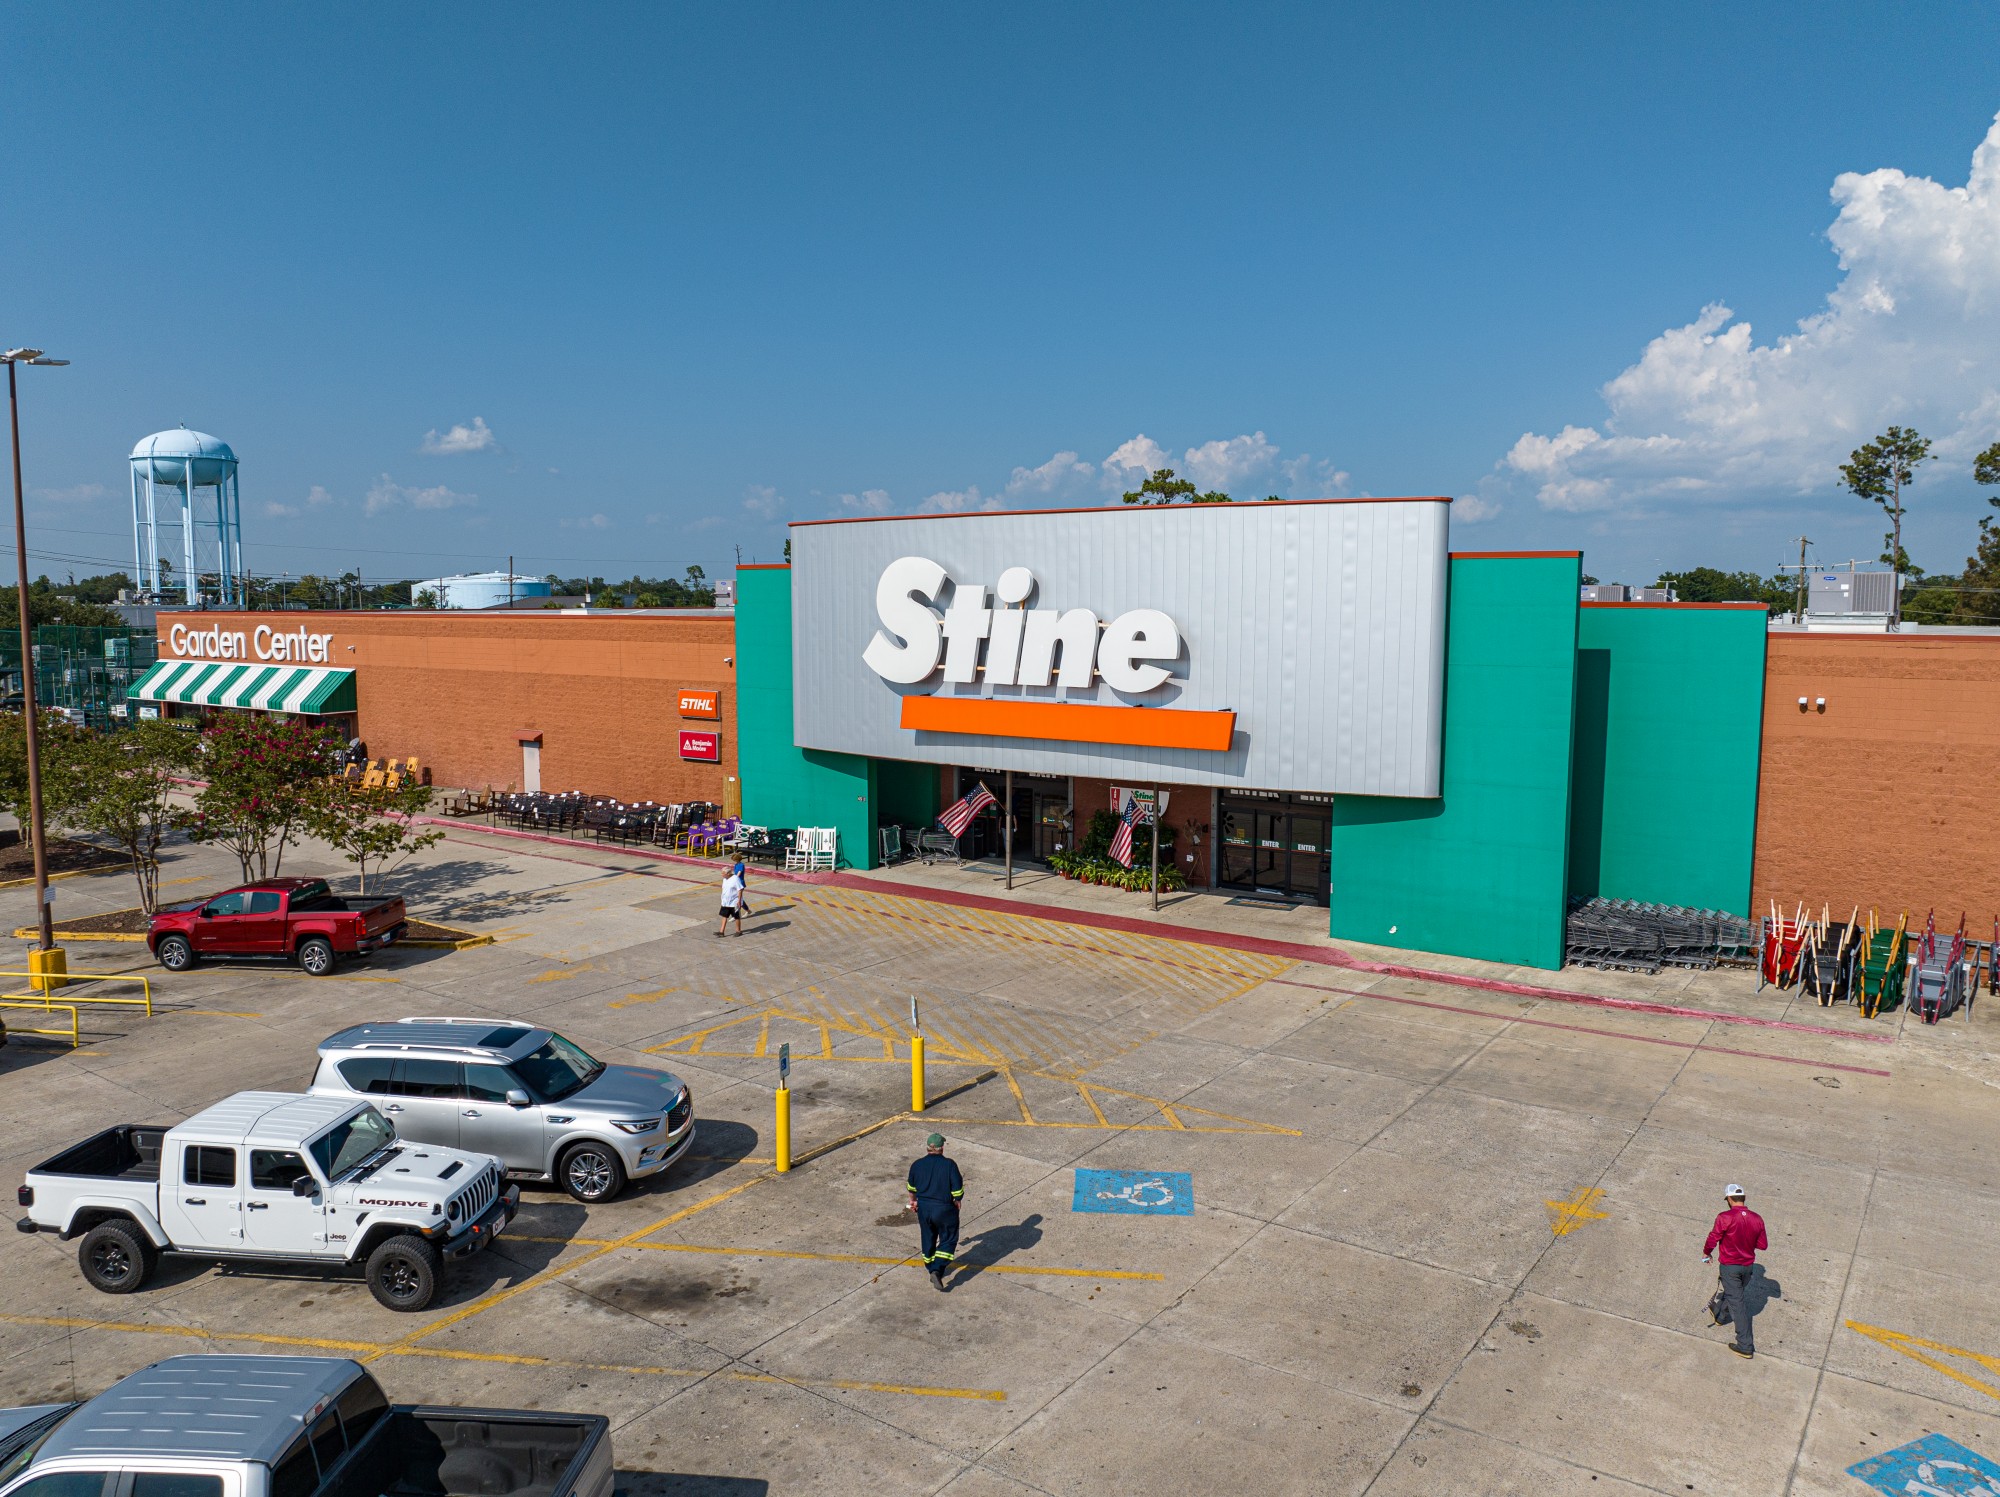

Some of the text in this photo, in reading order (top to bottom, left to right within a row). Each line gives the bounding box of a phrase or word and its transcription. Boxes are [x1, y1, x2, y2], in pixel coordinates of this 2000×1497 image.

[862, 556, 1181, 693] Stine
[170, 623, 333, 663] Garden Center
[680, 698, 712, 711] STIHL
[1261, 839, 1280, 848] ENTER
[1297, 843, 1316, 852] ENTER
[359, 1198, 429, 1208] MOJAVE
[329, 1233, 347, 1241] Jeep
